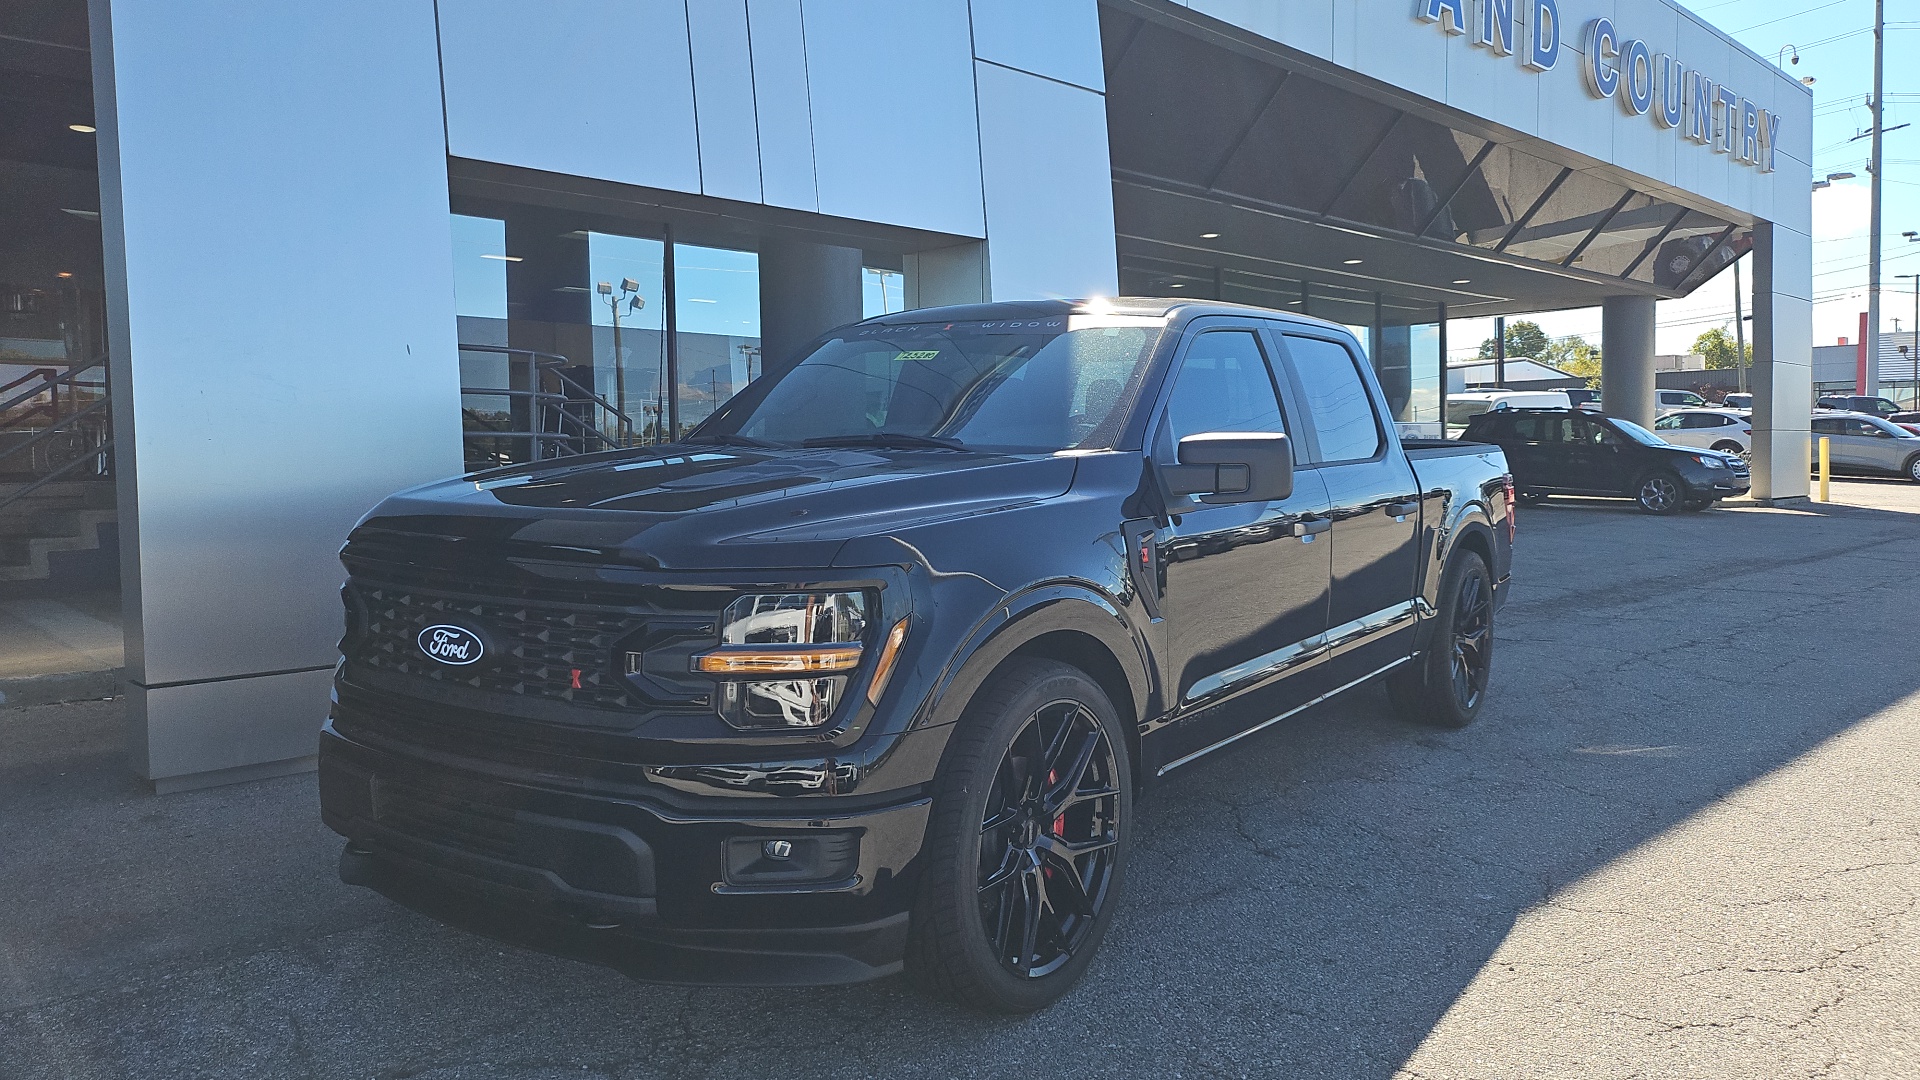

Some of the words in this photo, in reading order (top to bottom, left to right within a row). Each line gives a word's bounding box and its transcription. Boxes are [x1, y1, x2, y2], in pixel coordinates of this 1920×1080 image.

[1586, 18, 1781, 173] COUNTRY
[858, 326, 919, 336] BLACK
[429, 629, 470, 659] Ford
